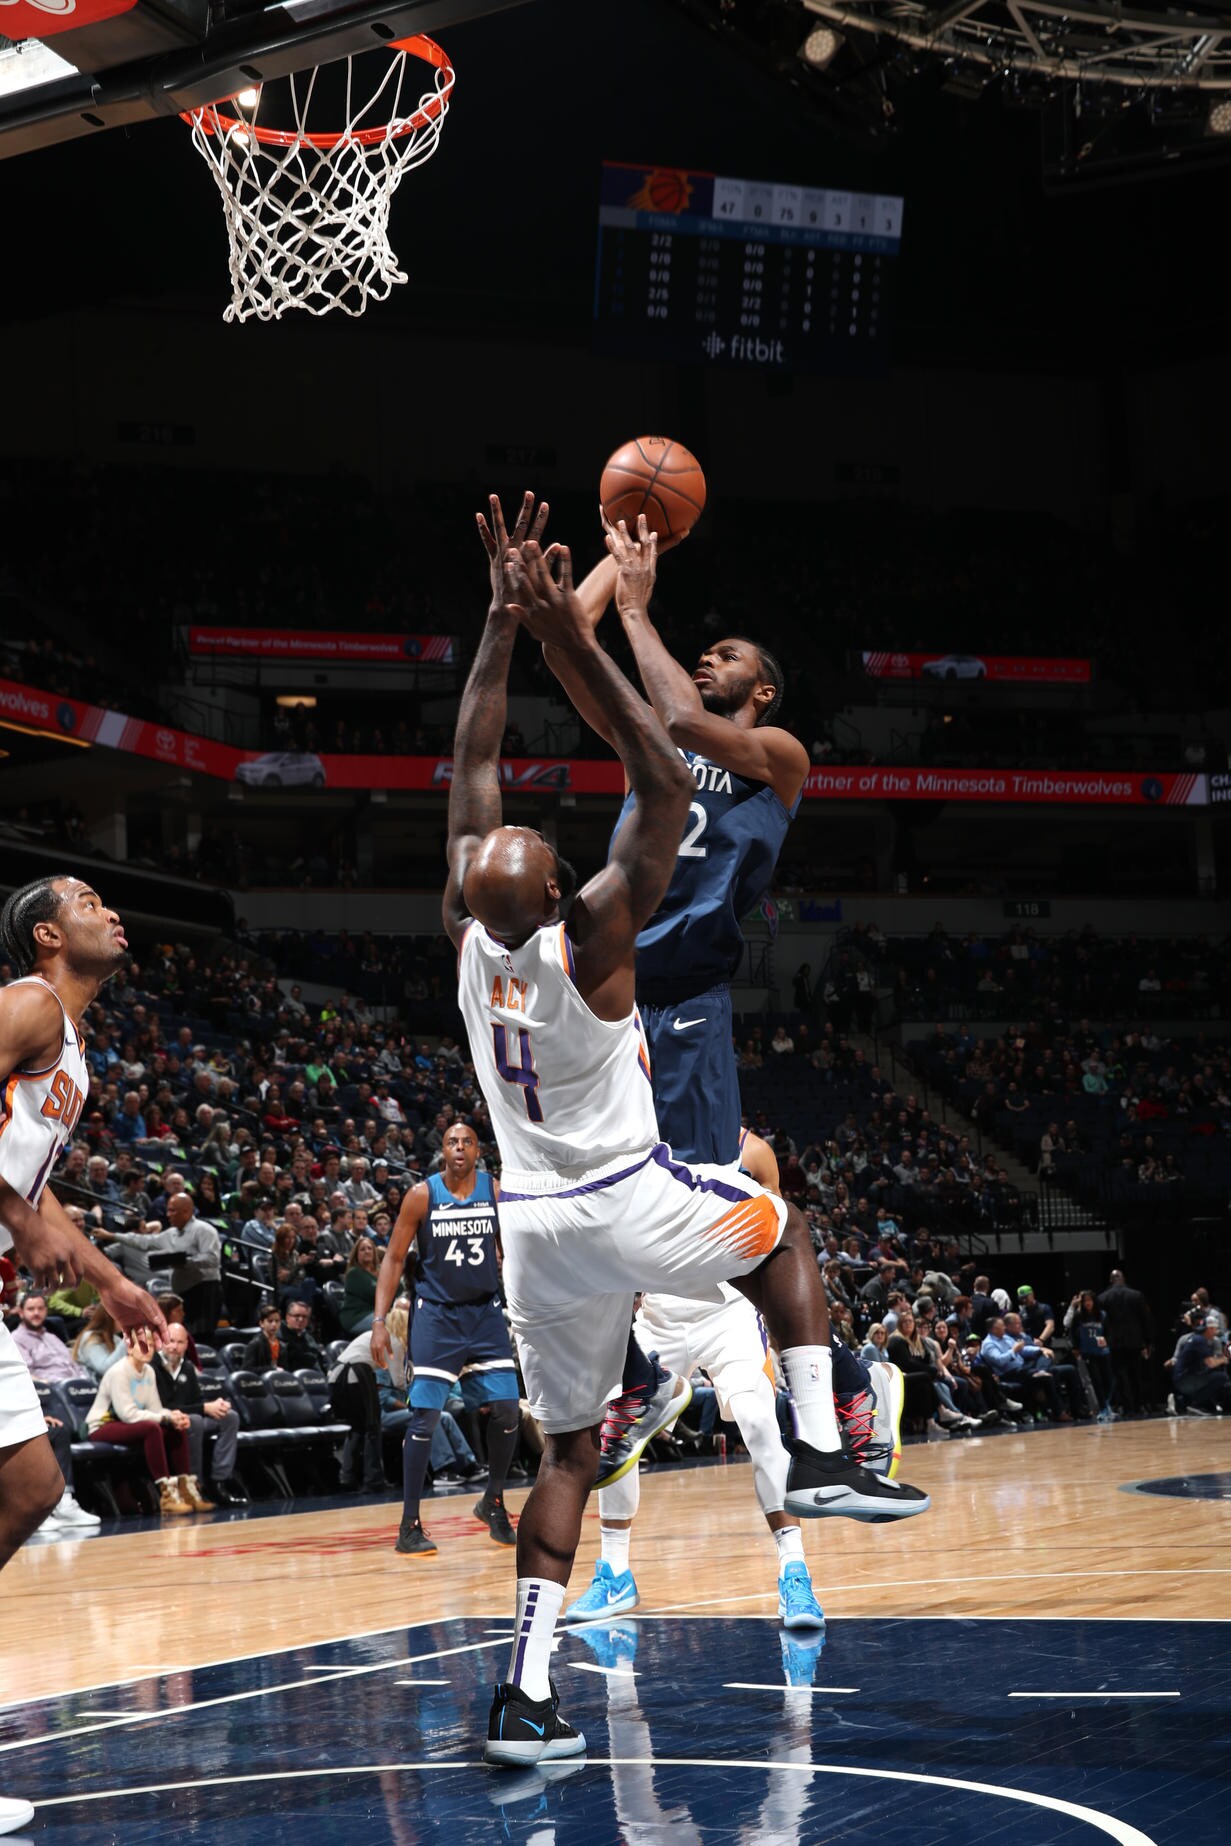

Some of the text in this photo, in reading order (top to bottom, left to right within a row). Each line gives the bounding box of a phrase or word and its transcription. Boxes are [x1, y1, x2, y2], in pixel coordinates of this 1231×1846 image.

[719, 201, 736, 215] 47
[753, 203, 764, 219] 0
[780, 207, 795, 222] 75
[834, 212, 842, 227] 3
[860, 215, 867, 229] 1
[885, 218, 893, 232] 3
[731, 333, 784, 364] fitbit
[0, 690, 49, 721] wolves
[431, 760, 571, 790] RV4
[803, 773, 1133, 796] artner of the Minnesota Timberwolves
[1211, 774, 1231, 787] CH
[1015, 902, 1040, 916] 118
[490, 975, 529, 1013] ACY
[490, 1022, 544, 1122] 4
[431, 1218, 494, 1238] MINNESOTA
[444, 1237, 485, 1267] 43
